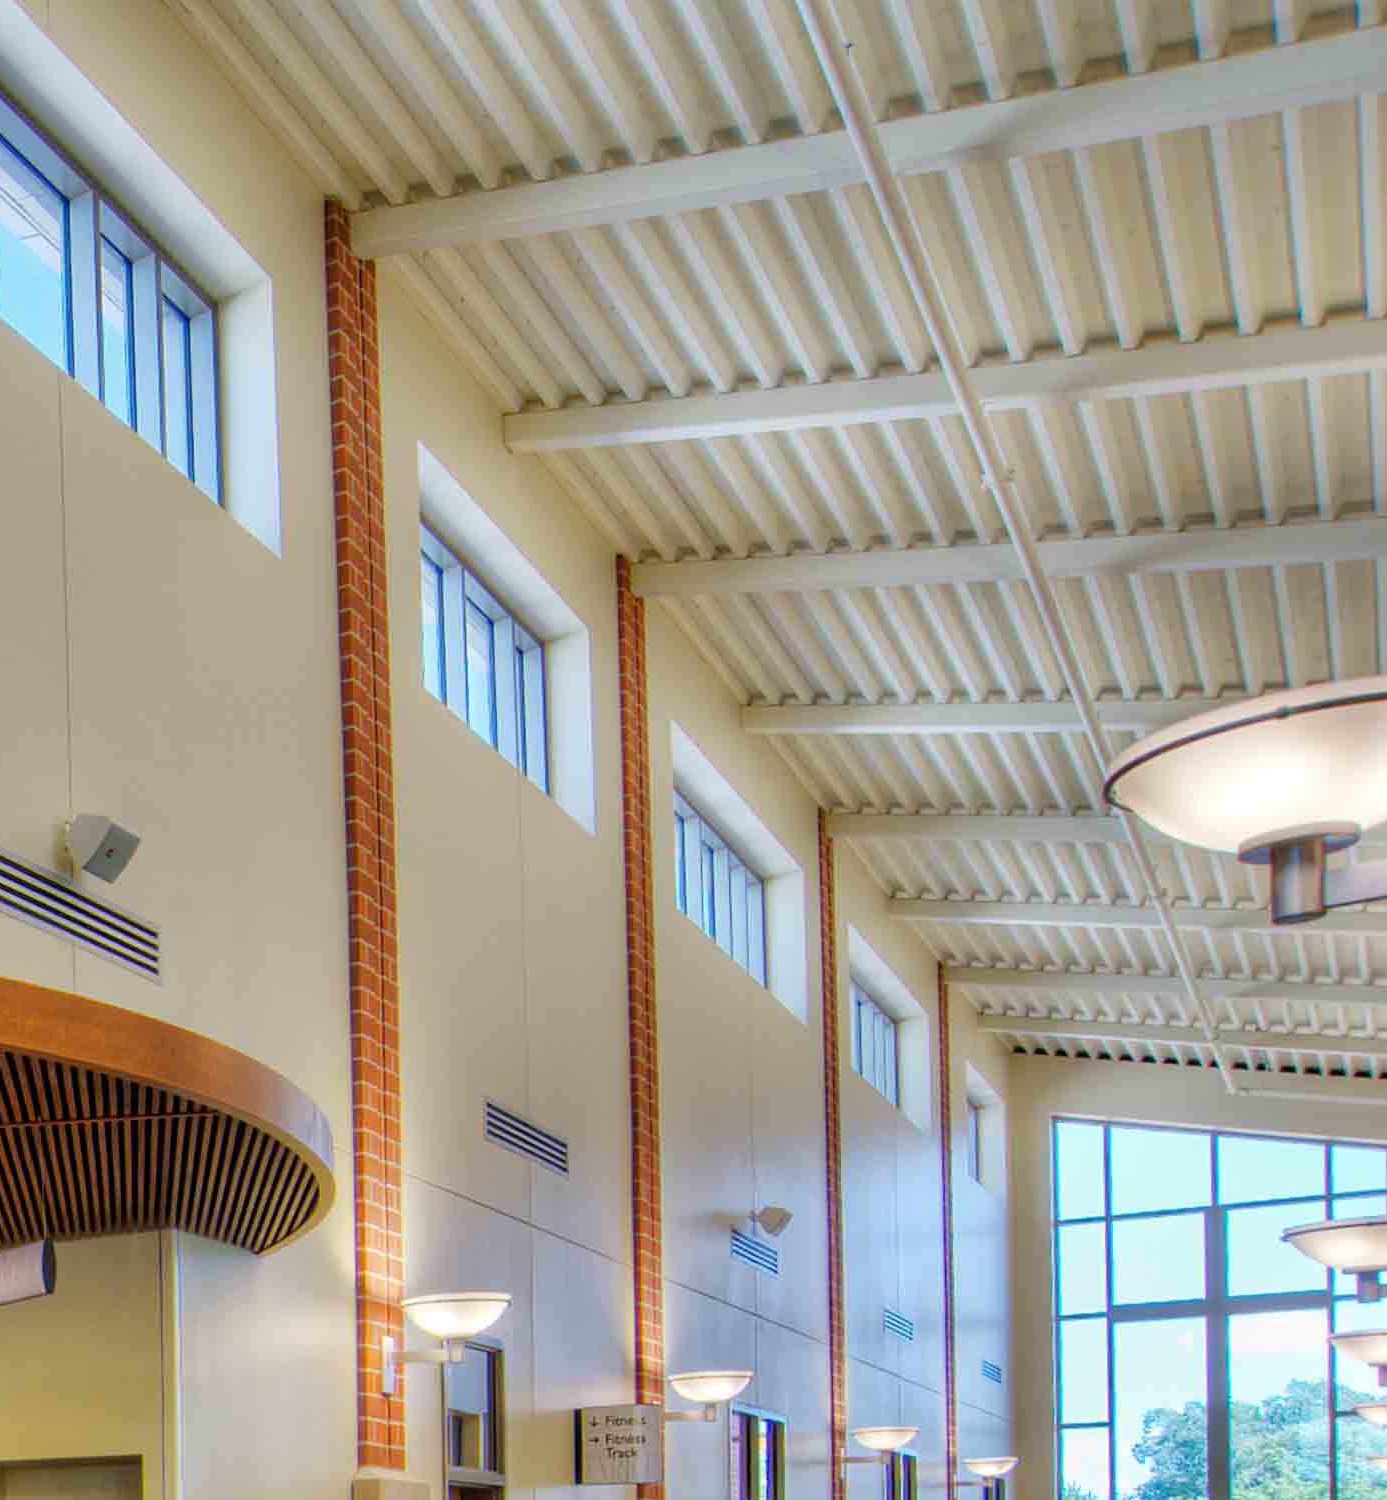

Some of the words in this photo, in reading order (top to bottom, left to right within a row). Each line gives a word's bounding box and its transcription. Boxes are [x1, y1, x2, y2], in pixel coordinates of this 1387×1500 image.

[605, 1415, 647, 1426] Fitnes
[605, 1433, 647, 1445] Fitness
[606, 1447, 639, 1459] Track
